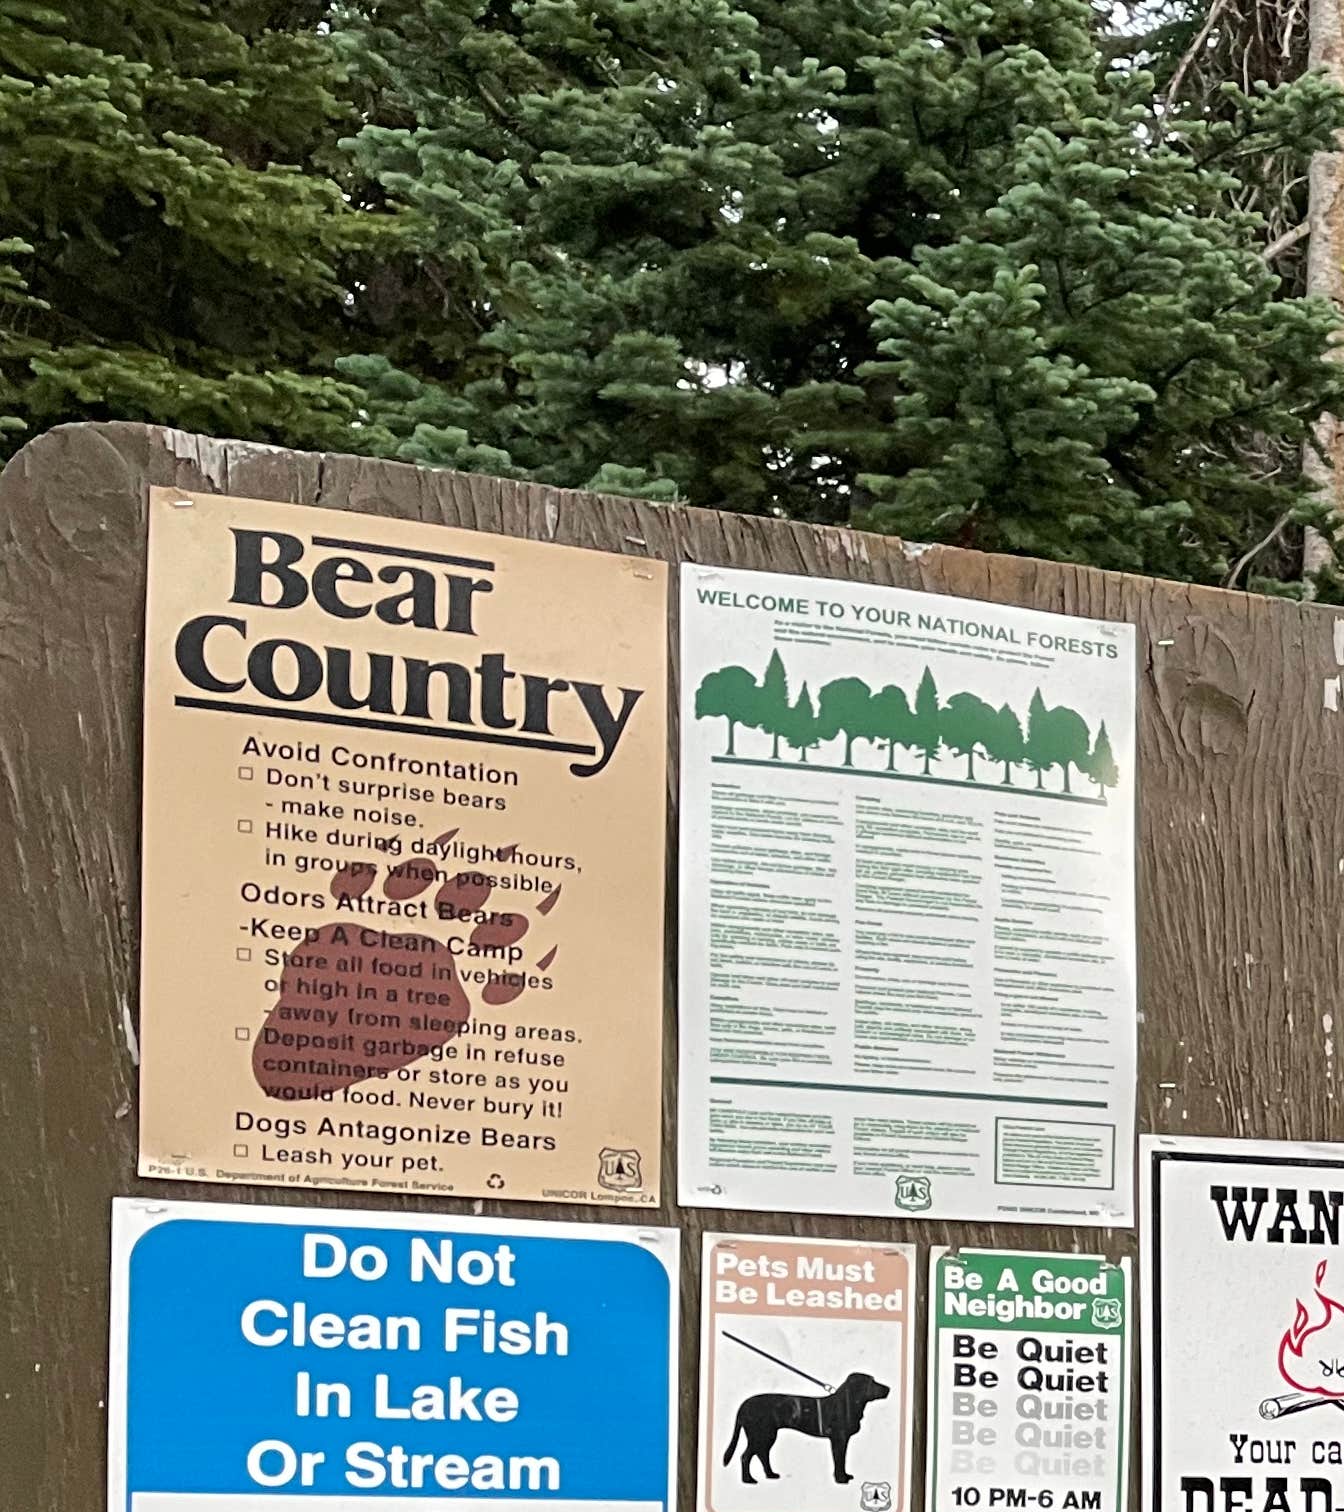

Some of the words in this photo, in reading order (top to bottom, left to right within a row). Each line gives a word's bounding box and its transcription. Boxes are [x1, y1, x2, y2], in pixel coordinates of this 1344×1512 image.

[228, 528, 495, 639] Bear
[697, 589, 808, 614] WELCOME
[816, 601, 844, 618] TO
[851, 605, 911, 627] YOUR
[918, 614, 1020, 644] NATIONAL
[1028, 630, 1118, 661] FORESTS
[174, 614, 645, 778] Country
[243, 737, 319, 763] Avoid
[332, 747, 517, 786] Confrontation
[268, 768, 329, 791] Don't
[339, 780, 434, 805] surprise
[444, 788, 505, 810] bears
[236, 1112, 306, 1138] Dogs
[318, 1118, 470, 1145] Antagonize
[482, 1128, 555, 1150] Bears
[263, 1144, 331, 1164] Leash
[342, 1154, 393, 1169] your
[403, 1156, 443, 1173] pet.
[304, 1234, 387, 1280] Do
[411, 1238, 515, 1286] Not
[717, 1252, 788, 1278] Pets
[797, 1257, 875, 1282] Must
[716, 1280, 758, 1304] Be
[767, 1283, 902, 1311] Leashed
[945, 1266, 982, 1290] Be
[997, 1269, 1018, 1291] A
[1032, 1270, 1107, 1295] Good
[945, 1292, 1086, 1322] Neighbor
[242, 1300, 420, 1350] Clean
[446, 1309, 567, 1355] Fish
[953, 1335, 998, 1359] Be
[1017, 1338, 1107, 1364] Quiet
[297, 1372, 350, 1417] In
[376, 1374, 518, 1422] Lake
[248, 1440, 324, 1486] Or
[345, 1442, 559, 1489] Stream
[1230, 1434, 1296, 1464] Your
[952, 1487, 980, 1506] 10
[1063, 1491, 1101, 1509] AM
